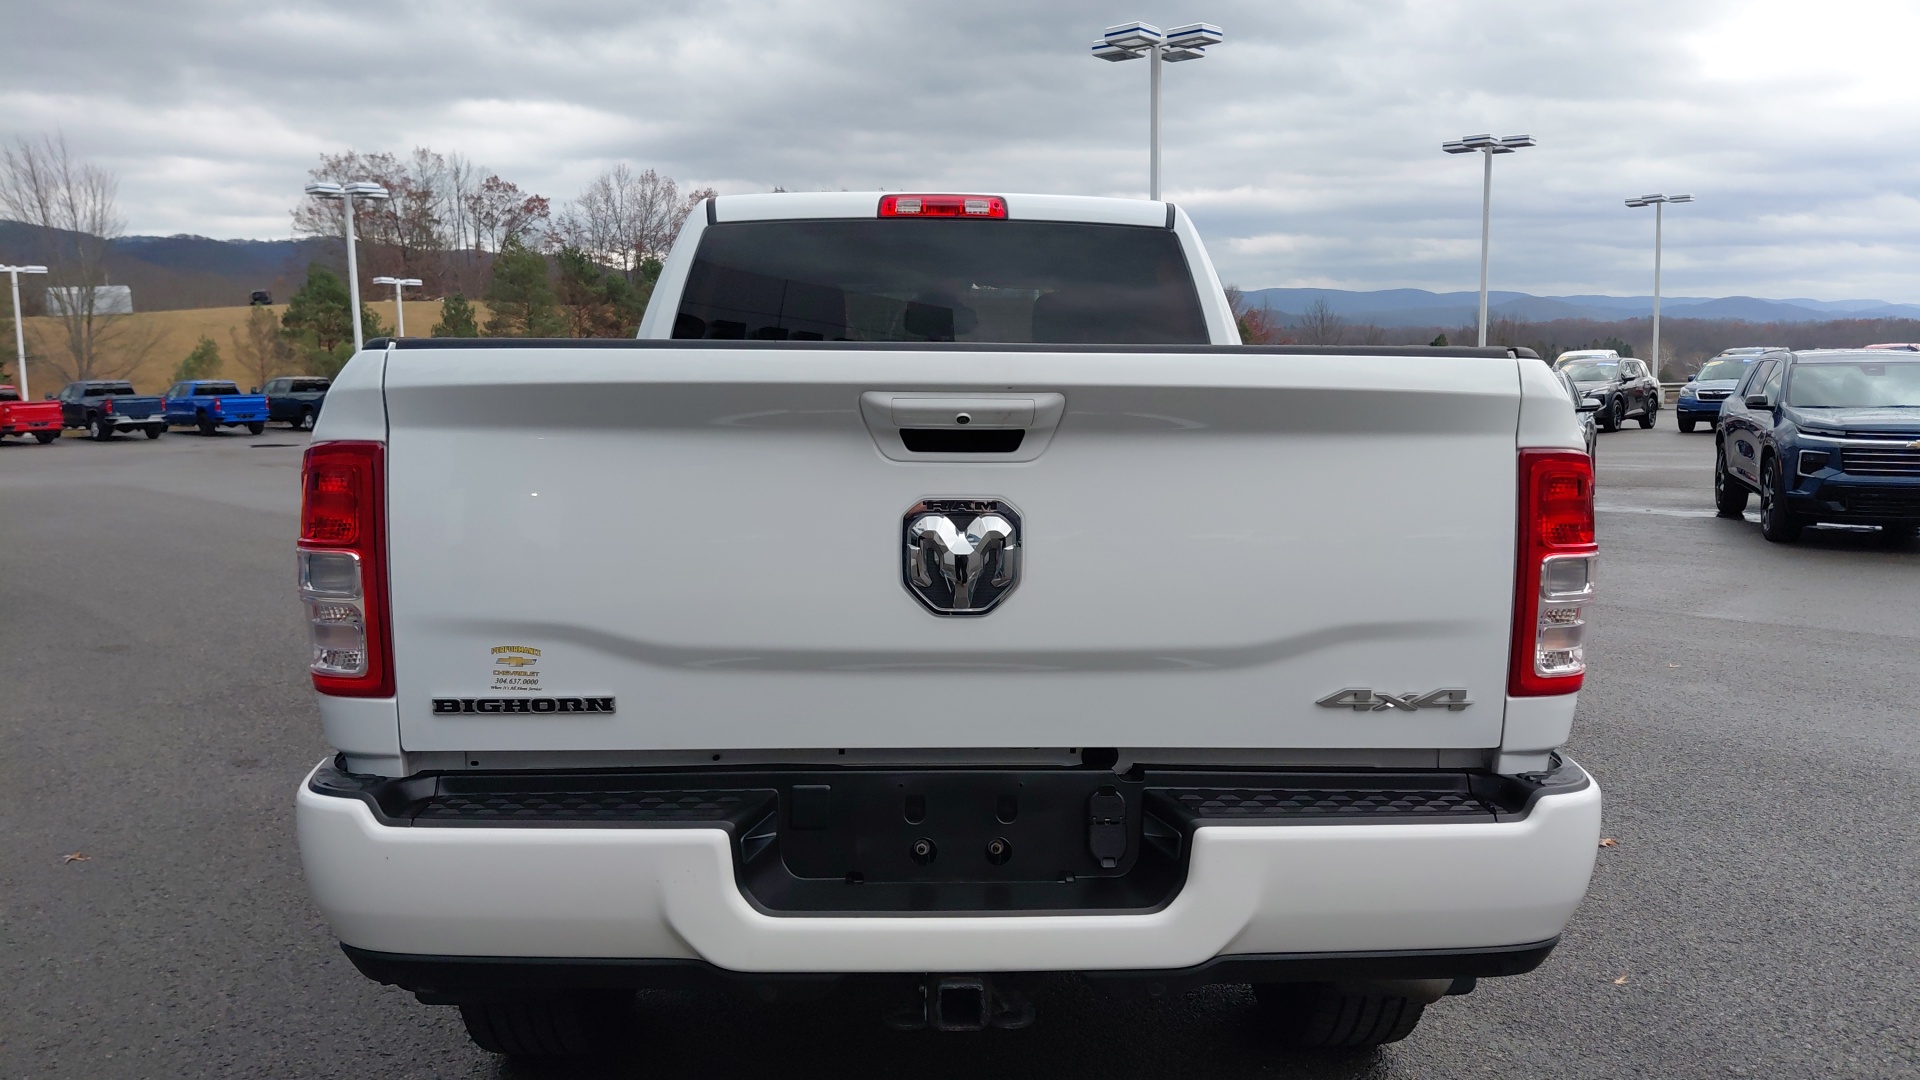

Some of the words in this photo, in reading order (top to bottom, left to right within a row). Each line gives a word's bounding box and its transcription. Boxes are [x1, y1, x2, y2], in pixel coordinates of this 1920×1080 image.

[923, 500, 998, 512] RAM
[491, 645, 541, 657] PERFORMANCE
[494, 677, 539, 685] 304.637.0000
[432, 697, 616, 714] BIGHORN
[1315, 688, 1475, 711] 4x4
